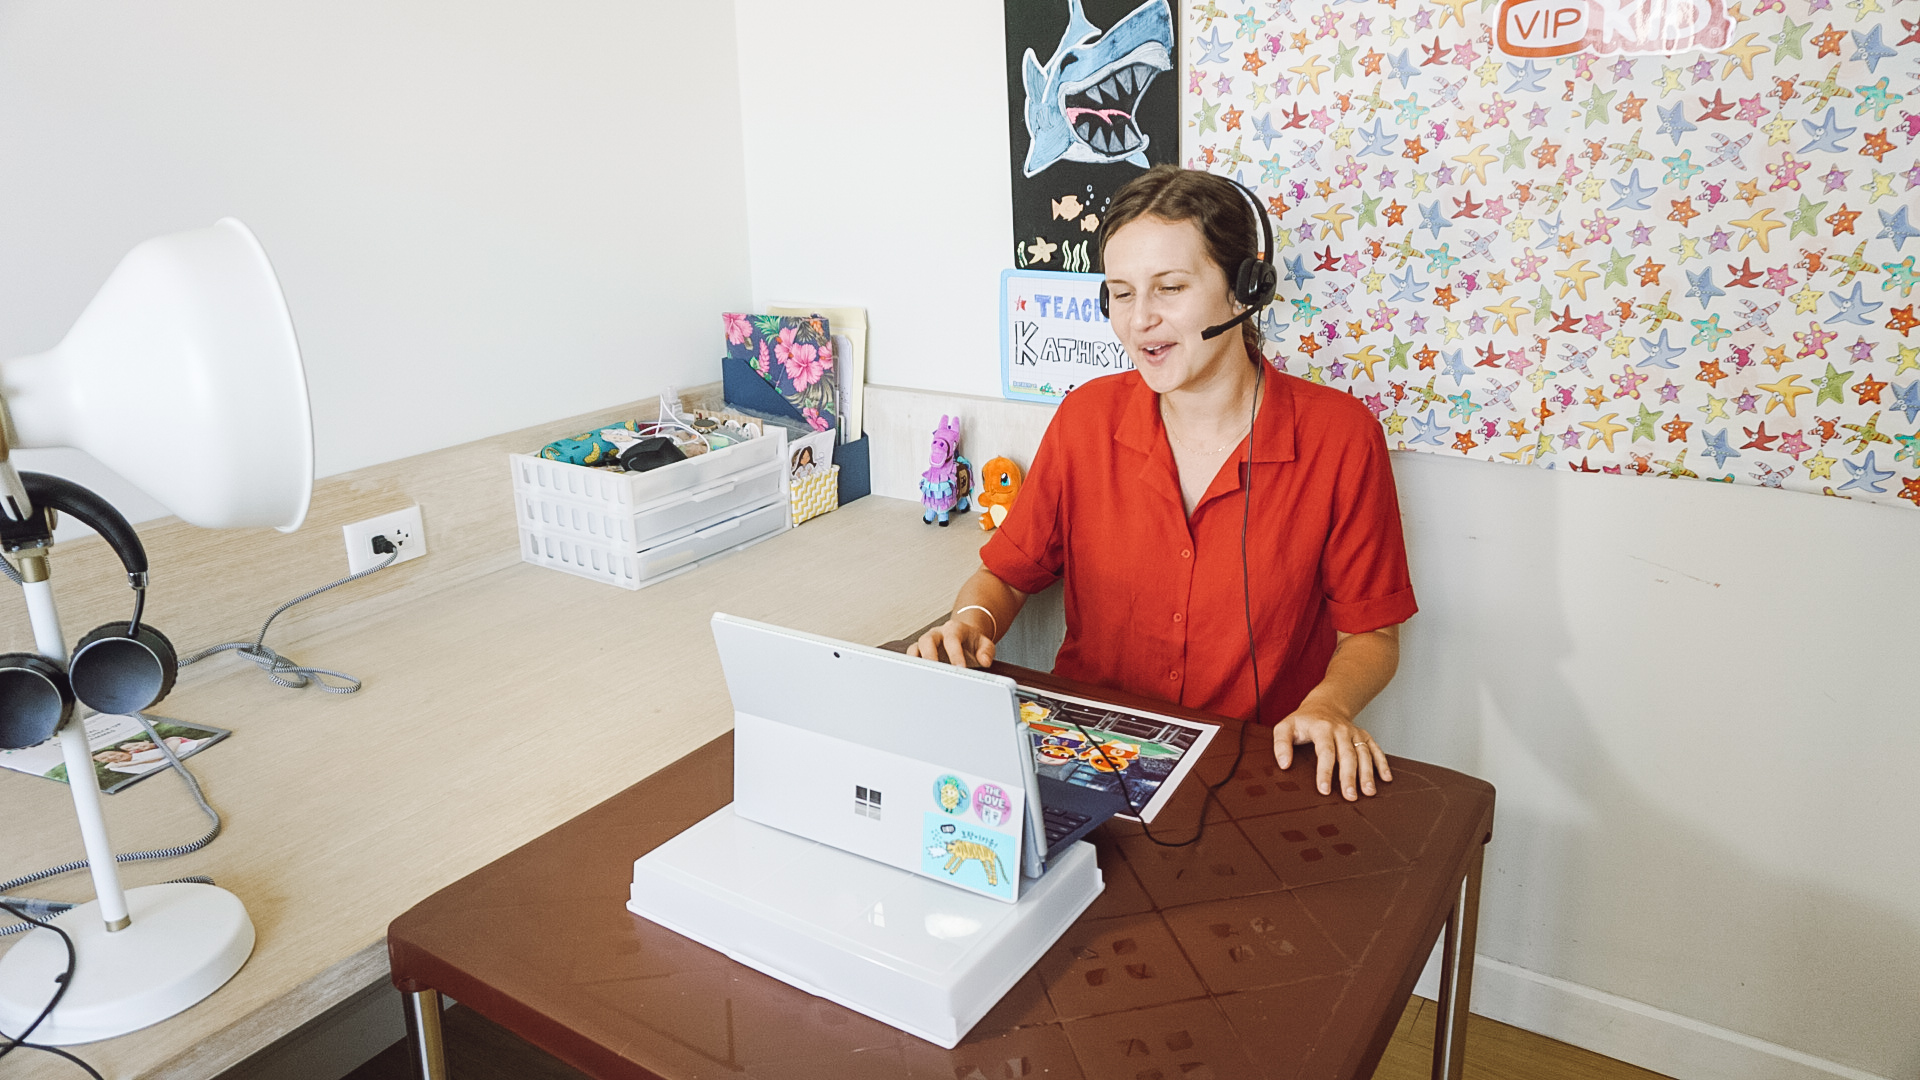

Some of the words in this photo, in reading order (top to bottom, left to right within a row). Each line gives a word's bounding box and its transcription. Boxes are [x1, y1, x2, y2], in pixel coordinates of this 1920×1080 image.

[1513, 7, 1582, 40] VIP
[985, 785, 1002, 797] THE
[978, 792, 1006, 809] LOVE
